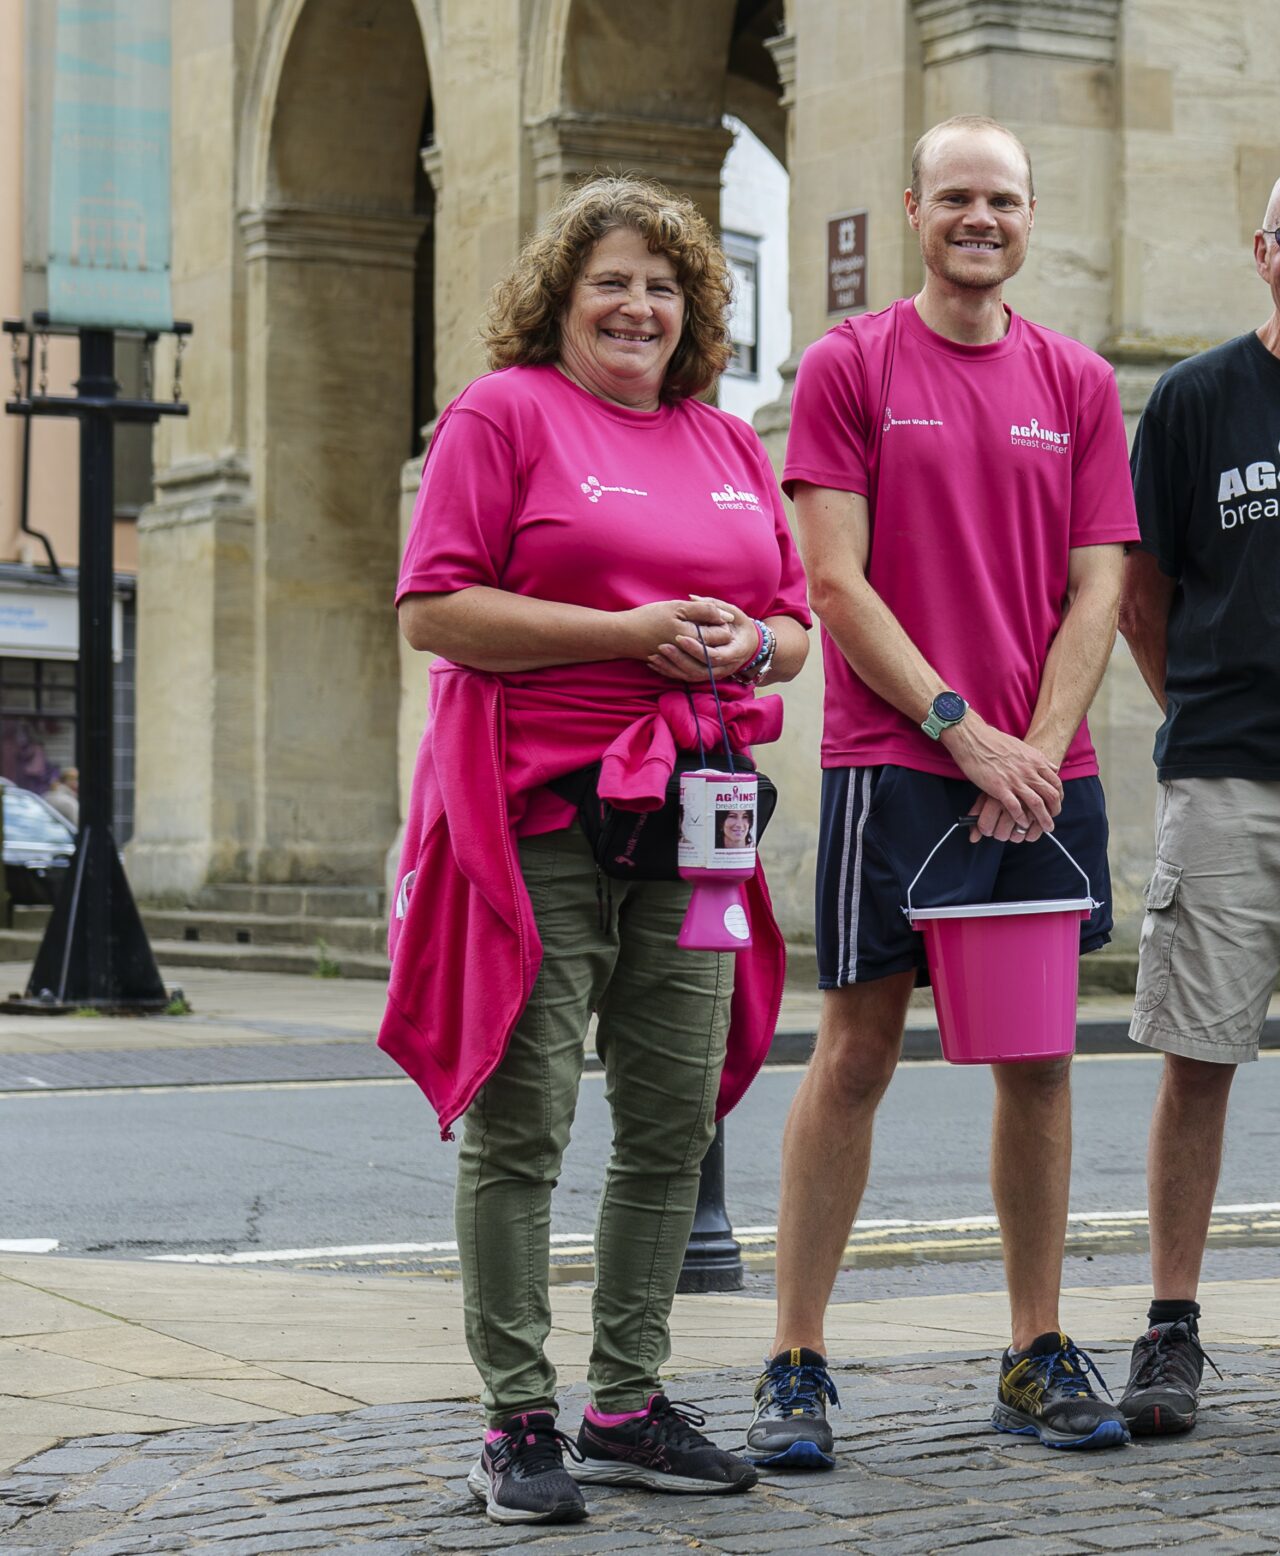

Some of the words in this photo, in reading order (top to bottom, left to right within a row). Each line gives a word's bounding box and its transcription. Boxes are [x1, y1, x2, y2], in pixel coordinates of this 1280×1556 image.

[1010, 418, 1070, 445] AGAINST
[1011, 436, 1039, 449] breast
[1041, 442, 1068, 454] cancer
[715, 502, 746, 510] breast
[716, 786, 756, 801] AGAINST
